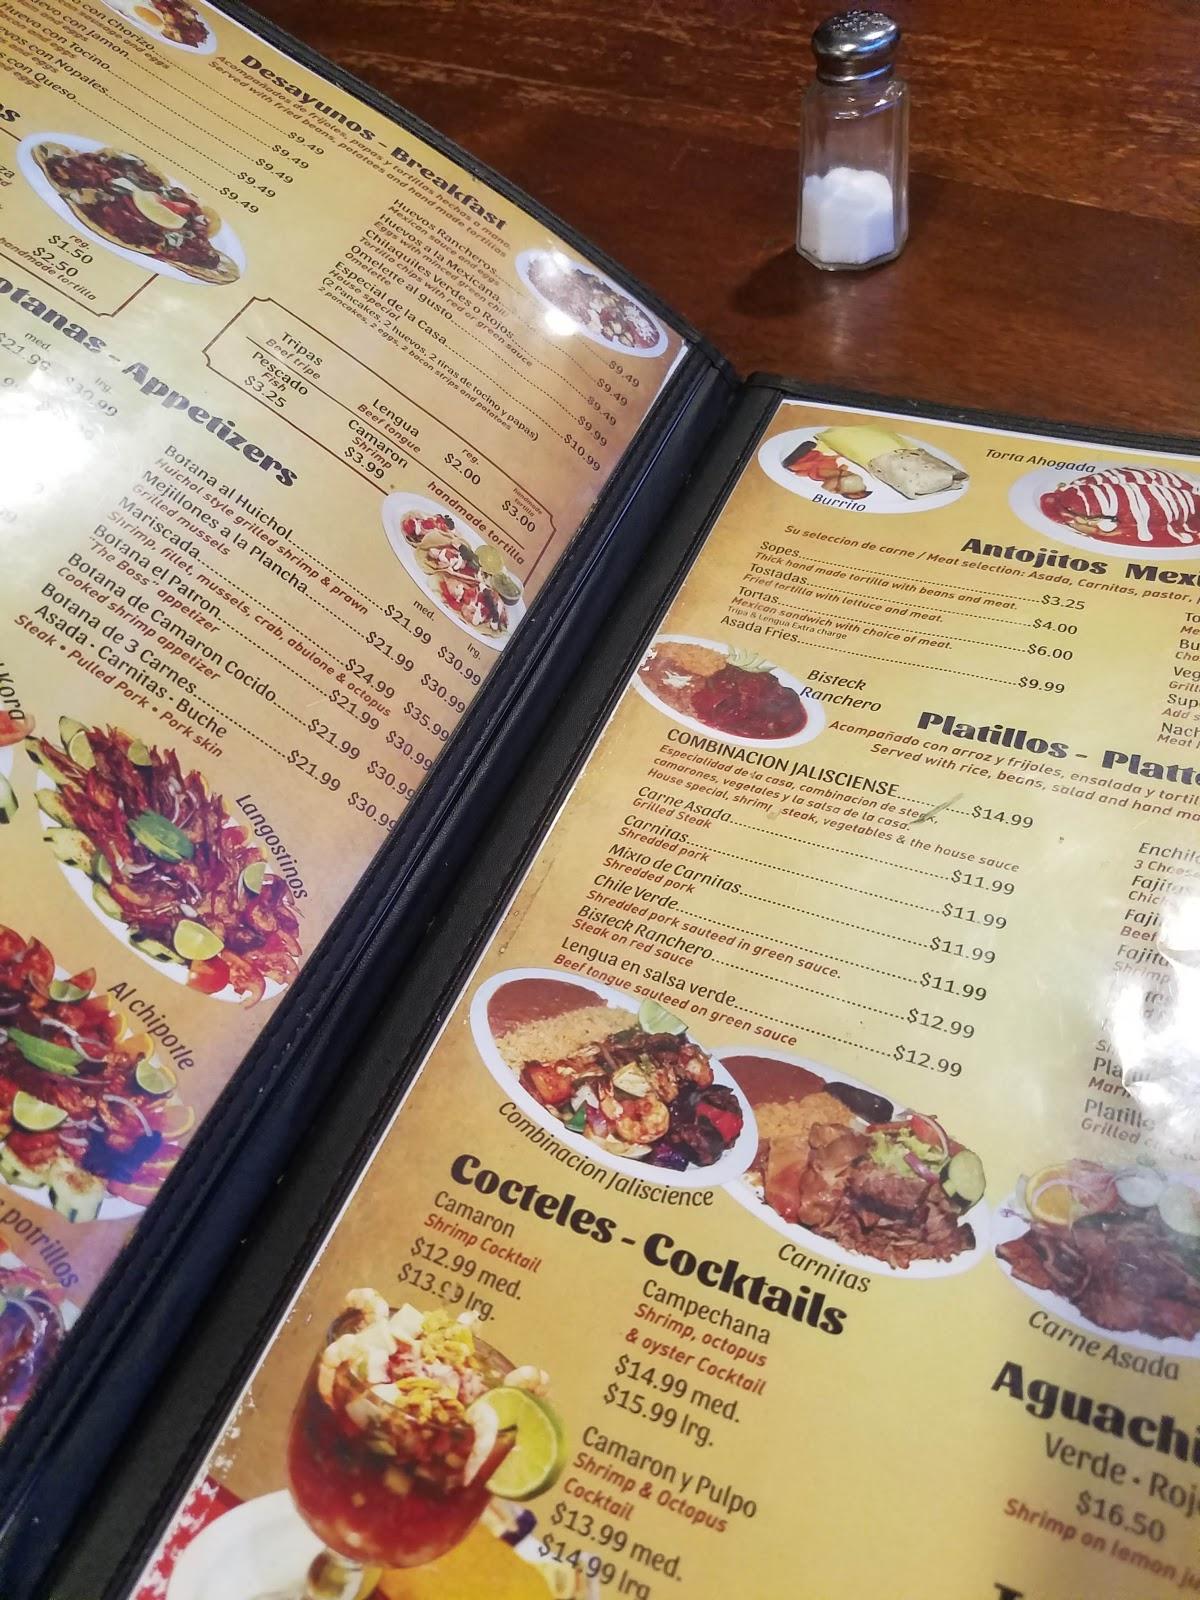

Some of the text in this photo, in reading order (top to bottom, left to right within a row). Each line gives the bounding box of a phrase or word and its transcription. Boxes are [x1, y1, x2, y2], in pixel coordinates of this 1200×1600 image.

[42, 28, 110, 70] con Tocino
[62, 15, 129, 58] con Jamon
[82, 4, 155, 52] con Chorizo
[6, 58, 76, 100] con Queso
[35, 46, 109, 96] con Nopales
[240, 55, 506, 230] Desayunos Breakfast
[271, 144, 309, 169] $9.49
[287, 131, 325, 155] $9.49
[237, 172, 276, 198] $9.49
[255, 158, 294, 184] $9.49
[219, 187, 259, 214] $9.49
[32, 247, 79, 277] $2.50
[47, 235, 94, 264] $1.50
[379, 213, 500, 302] Huevos a la Mexicana
[393, 198, 497, 275] Huevos Rancheros
[334, 261, 447, 345] Especial de la Casa
[350, 245, 453, 320] Omelette al gusto
[365, 229, 514, 339] Chilaquiles Verdes o Rojos
[252, 351, 308, 395] Pescado
[281, 331, 323, 366] Tripas
[244, 375, 287, 408] $3.25
[372, 398, 420, 438] Lengua
[121, 362, 298, 487] Appetizers
[348, 419, 408, 469] Camaron
[577, 415, 608, 447] $9.99
[344, 446, 385, 479] $3.99
[444, 453, 481, 485] $2.00
[563, 434, 601, 471] $10.99
[986, 448, 1096, 473] Torta Ahogada
[427, 480, 525, 565] handmade tortilla
[501, 500, 536, 532] $3.00
[811, 493, 866, 512] Burrito
[142, 470, 414, 672] Mejillones a la Plancha $21.99
[164, 444, 481, 686] Botana al Huichol $21.99 $30.99
[755, 551, 784, 565] Thick
[785, 559, 815, 572] hand
[814, 567, 847, 579] made
[848, 573, 890, 587] tortilla
[891, 582, 917, 592] with
[918, 586, 956, 599] beans
[957, 594, 982, 604] and
[760, 541, 1086, 610] Sopes $3.25
[960, 538, 1108, 575] Antojitos
[118, 496, 395, 699] Mariscada $24.99
[739, 585, 1073, 661] Tortas $6.00
[750, 562, 1078, 635] Tostadas $4.00
[67, 552, 360, 760] Botana de Camaron Cocido $21.99
[720, 615, 1065, 694] Asada Fries $9.99
[806, 669, 867, 691] Bisteck
[14, 614, 223, 757] Steak Pulled Pork Pork skin
[41, 582, 341, 792] Botana de 3 Carnes $21.99
[328, 689, 380, 730] $21.99
[799, 686, 882, 712] Ranchero
[917, 711, 1069, 759] Platillos
[638, 786, 732, 822] Carne Asada
[667, 728, 1034, 829] COMBINACION JALISCIENSE $14.99
[236, 794, 308, 899] Langostinos
[608, 843, 742, 894] Mixto de Carnitas
[586, 890, 841, 979] Shredded pork sauteed in green sauce.
[561, 936, 962, 1077] Lengua en salsa verde $12.99
[919, 972, 987, 1001] $11.99
[107, 981, 195, 1070] Al chipotle
[499, 1101, 714, 1206] Combinacion Jaliscience
[434, 1190, 515, 1238] Camaron
[410, 1236, 522, 1301] $12.99 med.
[424, 1213, 542, 1274] Shrimp Cocktail
[450, 1154, 848, 1336] Cocteles Cocktails
[634, 1303, 768, 1367] Shrimp, octopus
[642, 1279, 771, 1345] Campechana
[614, 1353, 740, 1424] $14.99 med.
[624, 1327, 767, 1396] & oyster Cocktail
[603, 1382, 714, 1448] $15.99 lrg.
[582, 1426, 757, 1518] Camaron y Pulpo
[1045, 1432, 1127, 1486] Verde
[572, 1452, 728, 1533] Shrimp & Octopus
[1076, 1489, 1167, 1543] $16.50
[550, 1501, 682, 1582] $13.99 med.
